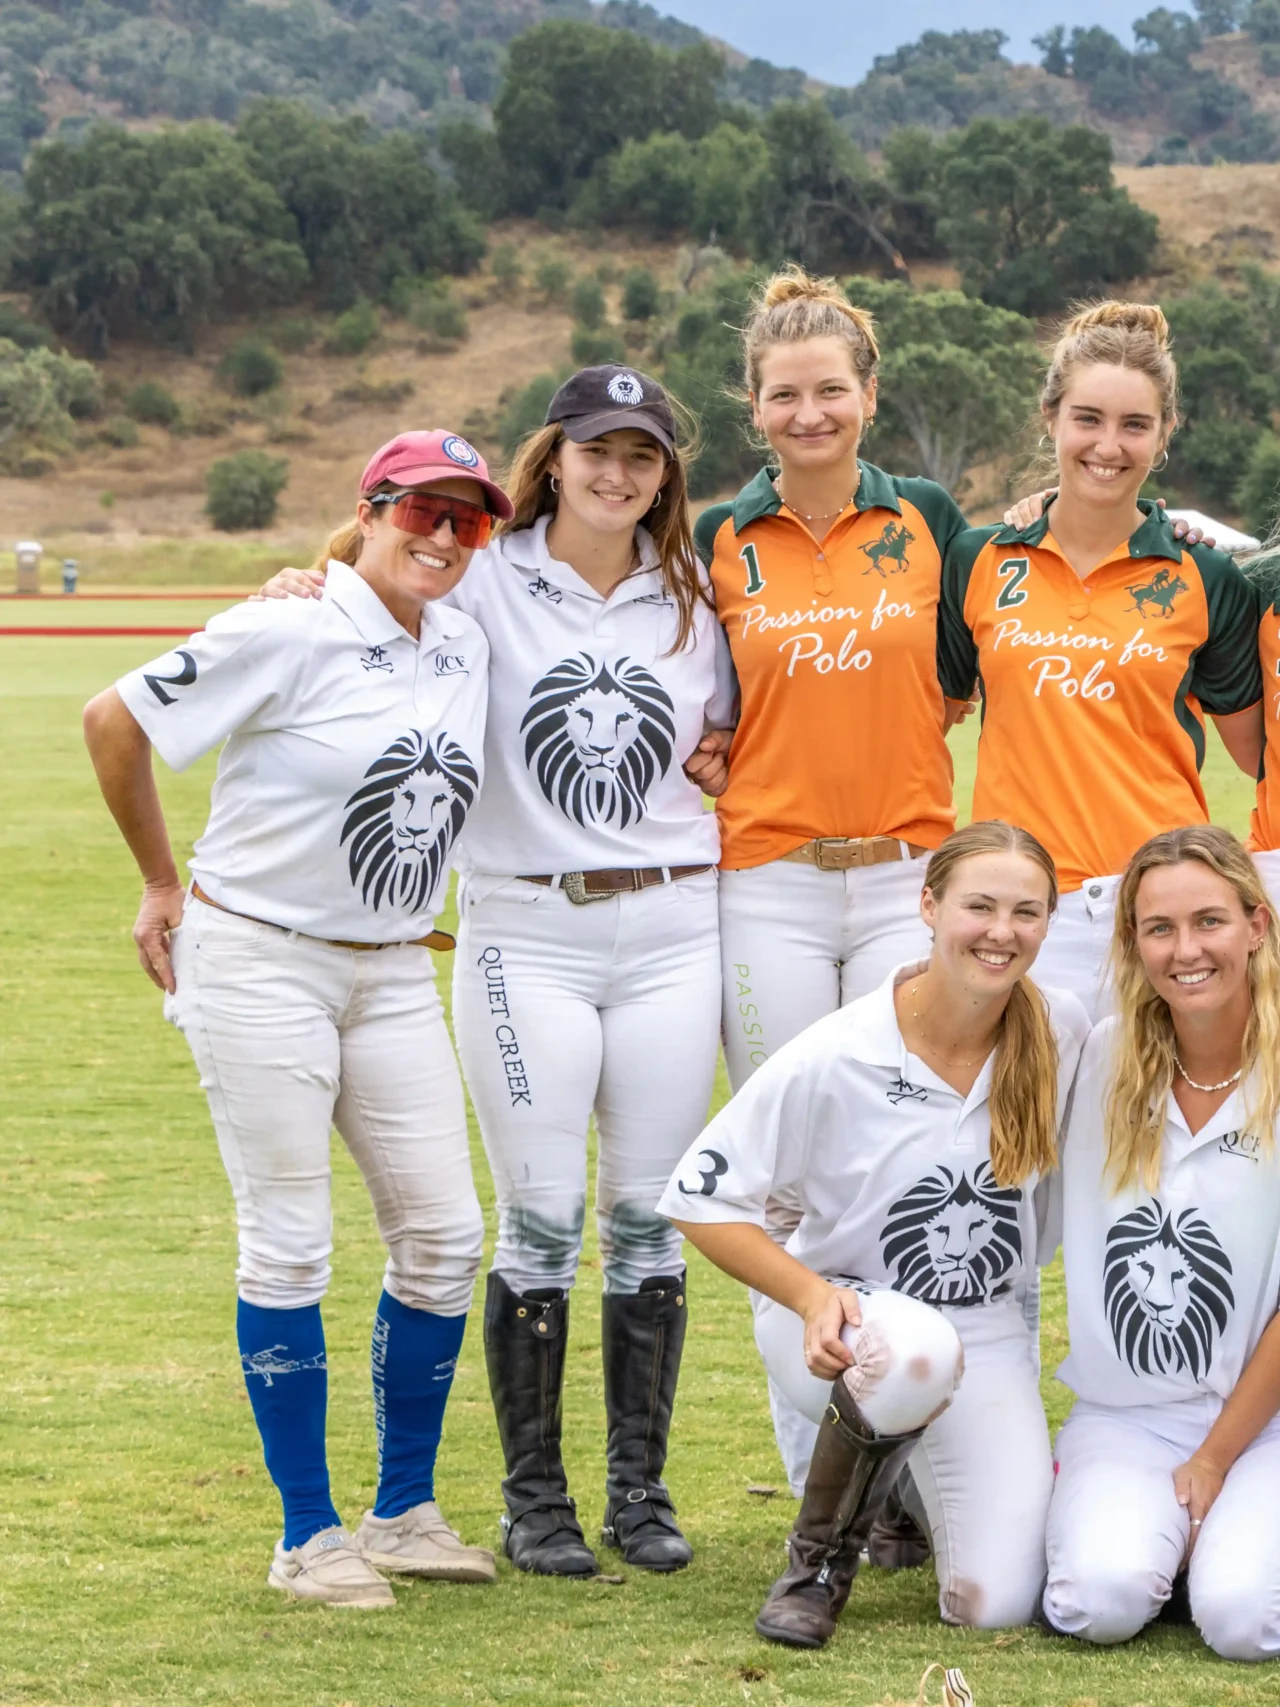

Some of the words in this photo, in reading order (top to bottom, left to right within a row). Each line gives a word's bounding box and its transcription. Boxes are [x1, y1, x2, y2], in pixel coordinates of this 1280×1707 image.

[739, 543, 766, 595] 1
[996, 557, 1030, 611] 2
[740, 600, 862, 639] Passion
[870, 589, 916, 631] for
[778, 629, 873, 677] Polo
[993, 619, 1114, 651] Passion
[1118, 628, 1168, 665] for
[143, 651, 197, 706] 2
[1027, 655, 1116, 700] Polo
[478, 947, 510, 1019] QUIET
[496, 1025, 532, 1107] CREEK
[678, 1149, 729, 1197] 3
